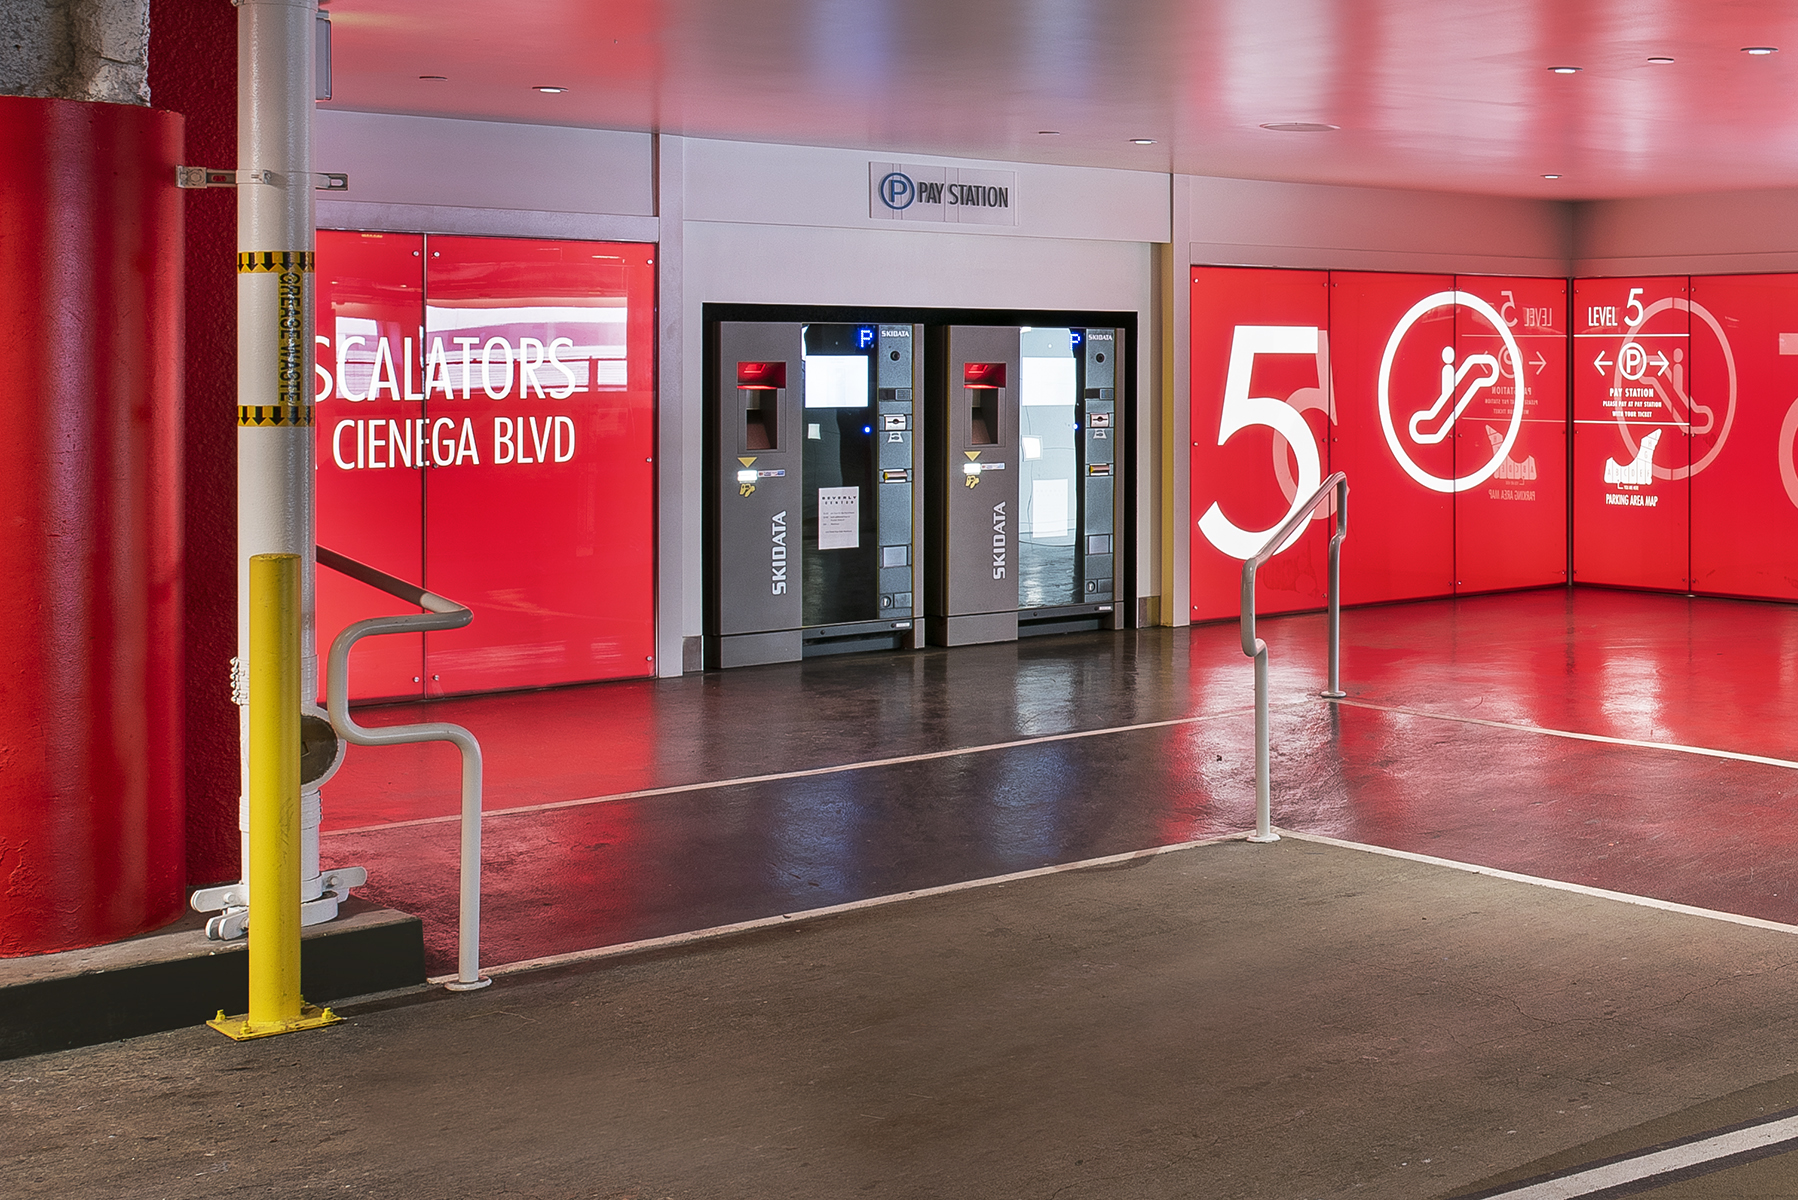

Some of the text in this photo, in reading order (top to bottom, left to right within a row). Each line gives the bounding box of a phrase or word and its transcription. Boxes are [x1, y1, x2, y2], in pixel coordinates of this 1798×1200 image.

[889, 179, 1009, 208] P PAY STATION
[1588, 287, 1644, 327] LEVEL 5
[279, 272, 301, 402] GREASE WASTE
[860, 329, 873, 348] P
[881, 330, 910, 338] SKIDATA
[1088, 333, 1113, 341] SKIDATA
[315, 336, 576, 402] SCALATORS
[1626, 349, 1641, 374] P
[1609, 387, 1654, 398] PAY STATION
[332, 416, 576, 470] CIENEGA BLVD
[1197, 325, 1321, 561] 5
[1605, 493, 1659, 508] PARKING AREA MAP
[771, 509, 787, 596] SKIDATA
[993, 500, 1006, 580] SKIDATA
